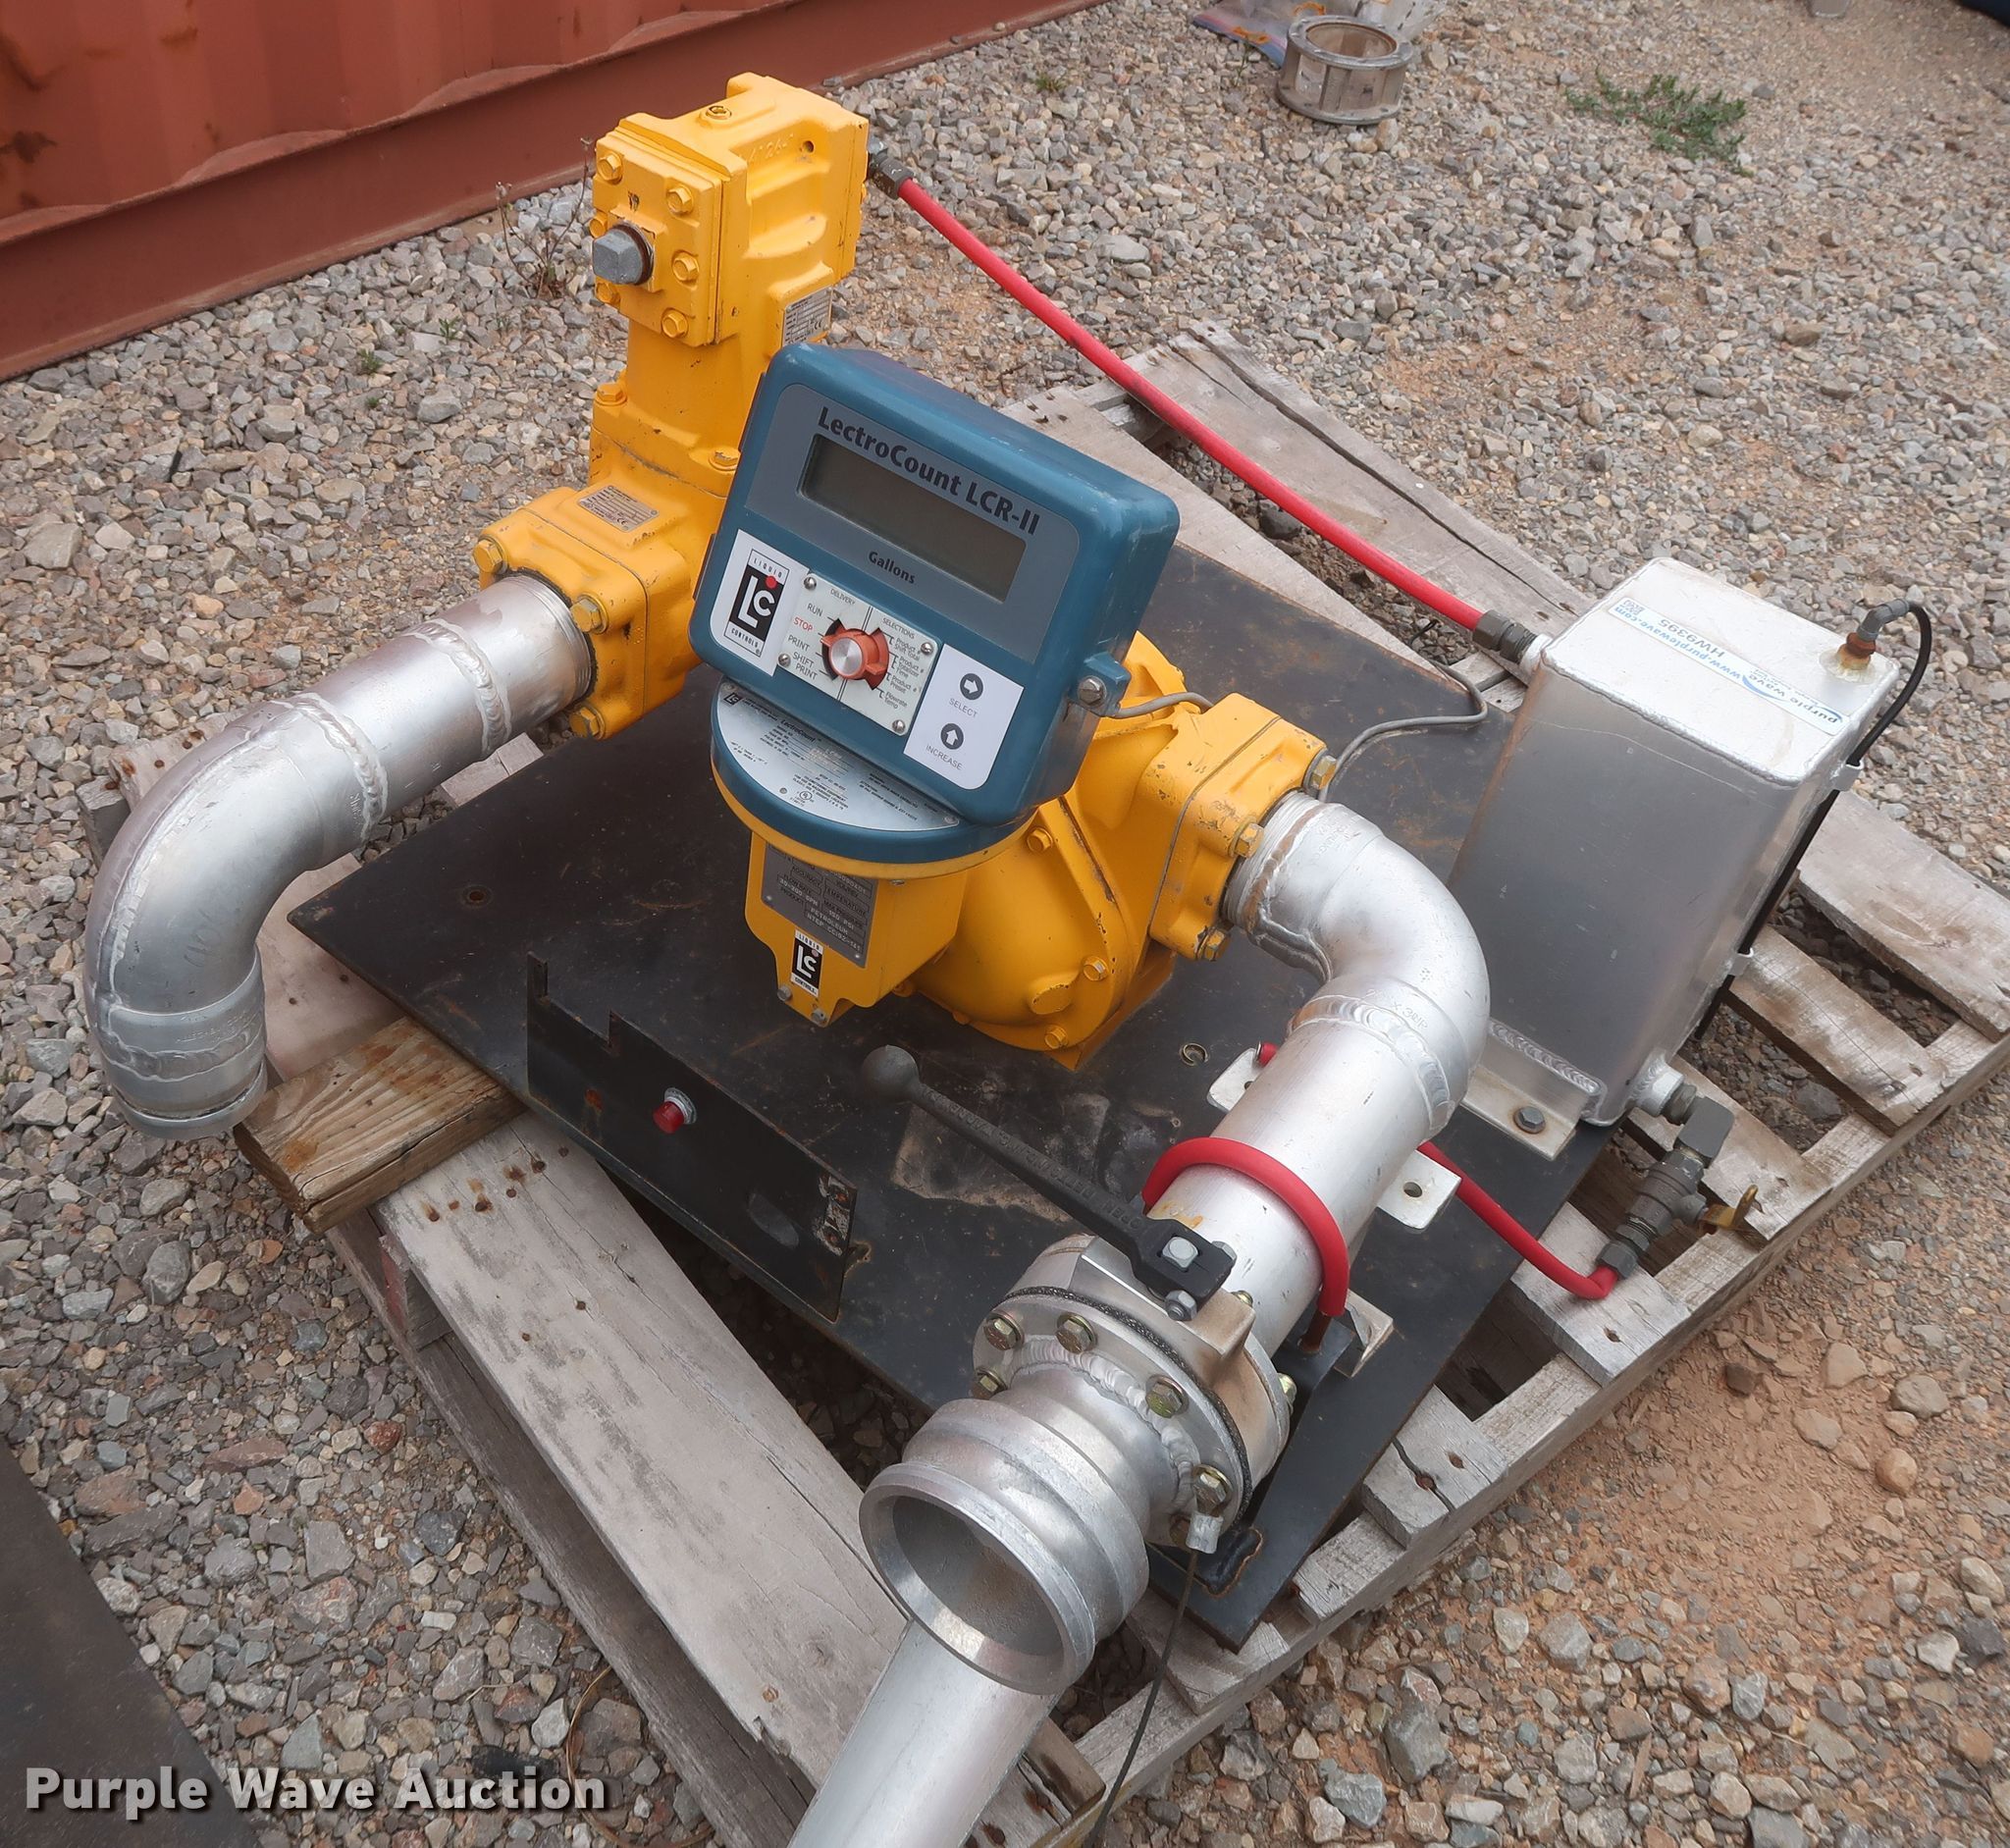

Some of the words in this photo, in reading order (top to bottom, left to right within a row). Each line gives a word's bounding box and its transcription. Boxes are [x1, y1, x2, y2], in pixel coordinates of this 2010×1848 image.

[818, 406, 962, 496] LectroCount
[966, 483, 1040, 535] LCR-II
[753, 557, 782, 578] LIQUID
[869, 551, 916, 584] Gallons
[830, 588, 856, 605] DELIVERY
[807, 603, 822, 617] RUN
[793, 616, 814, 632] STOP
[882, 617, 915, 639] SELECTIONS
[730, 627, 759, 648] CONTROLS
[788, 634, 811, 652] PRINT
[896, 638, 916, 653] Product
[1614, 606, 1742, 680] www.purplewave.com
[1659, 618, 1725, 659] HW9395
[793, 652, 815, 667] SHIFT
[900, 657, 920, 671] Product
[795, 662, 818, 680] PRINT
[891, 675, 912, 690] Product
[1749, 673, 1785, 697] wave
[885, 691, 908, 708] Flowrate
[949, 698, 978, 718] SELECT
[1789, 697, 1838, 724] purple
[926, 744, 963, 770] INCREASE
[811, 907, 849, 935] PETROLEUM
